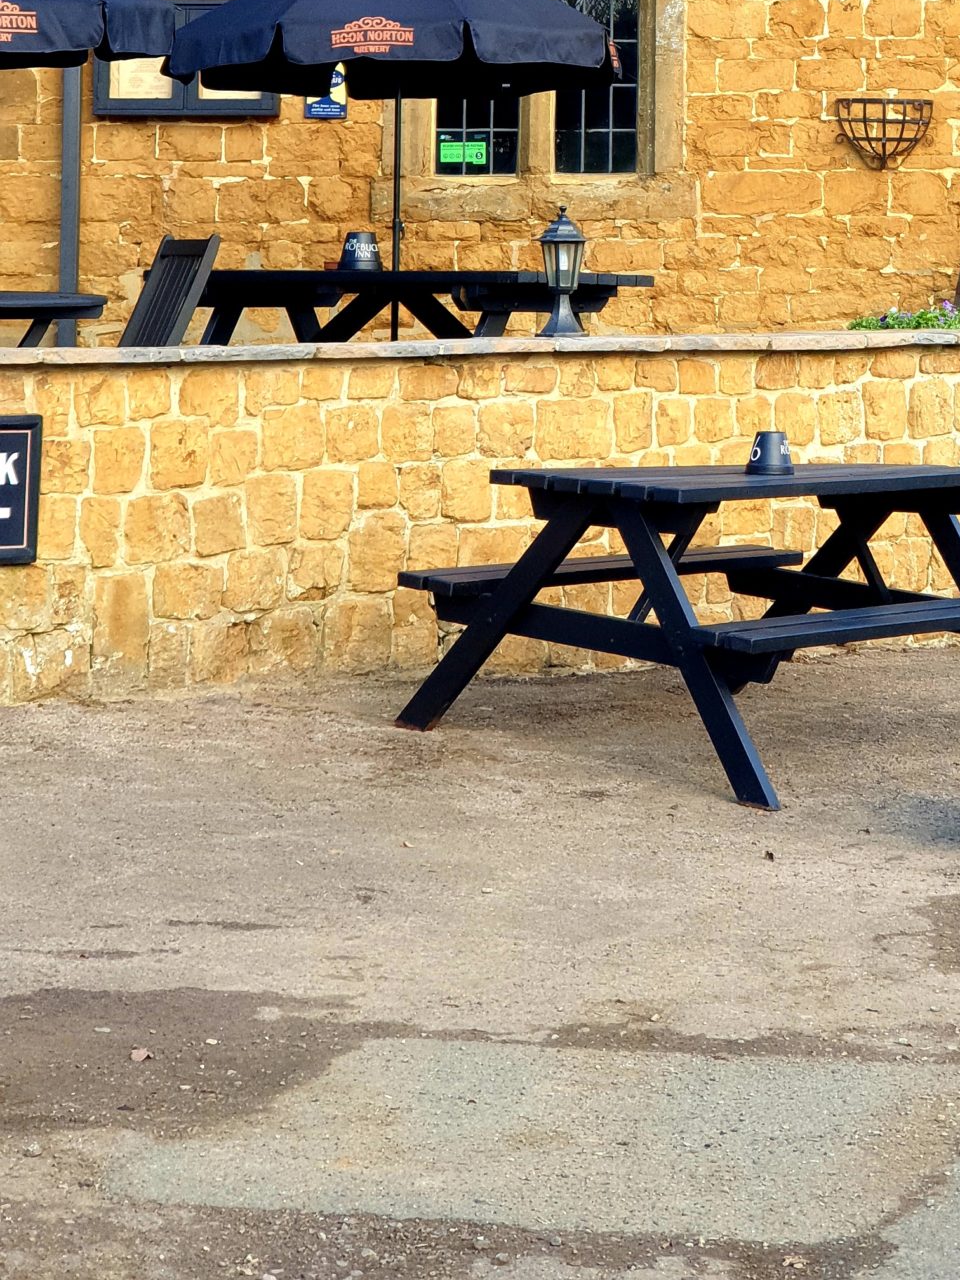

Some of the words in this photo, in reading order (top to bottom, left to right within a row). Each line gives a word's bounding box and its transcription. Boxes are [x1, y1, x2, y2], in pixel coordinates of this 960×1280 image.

[331, 31, 365, 45] HOOK
[367, 29, 414, 42] NORTON
[353, 45, 391, 54] BREWERY
[355, 250, 371, 258] INN
